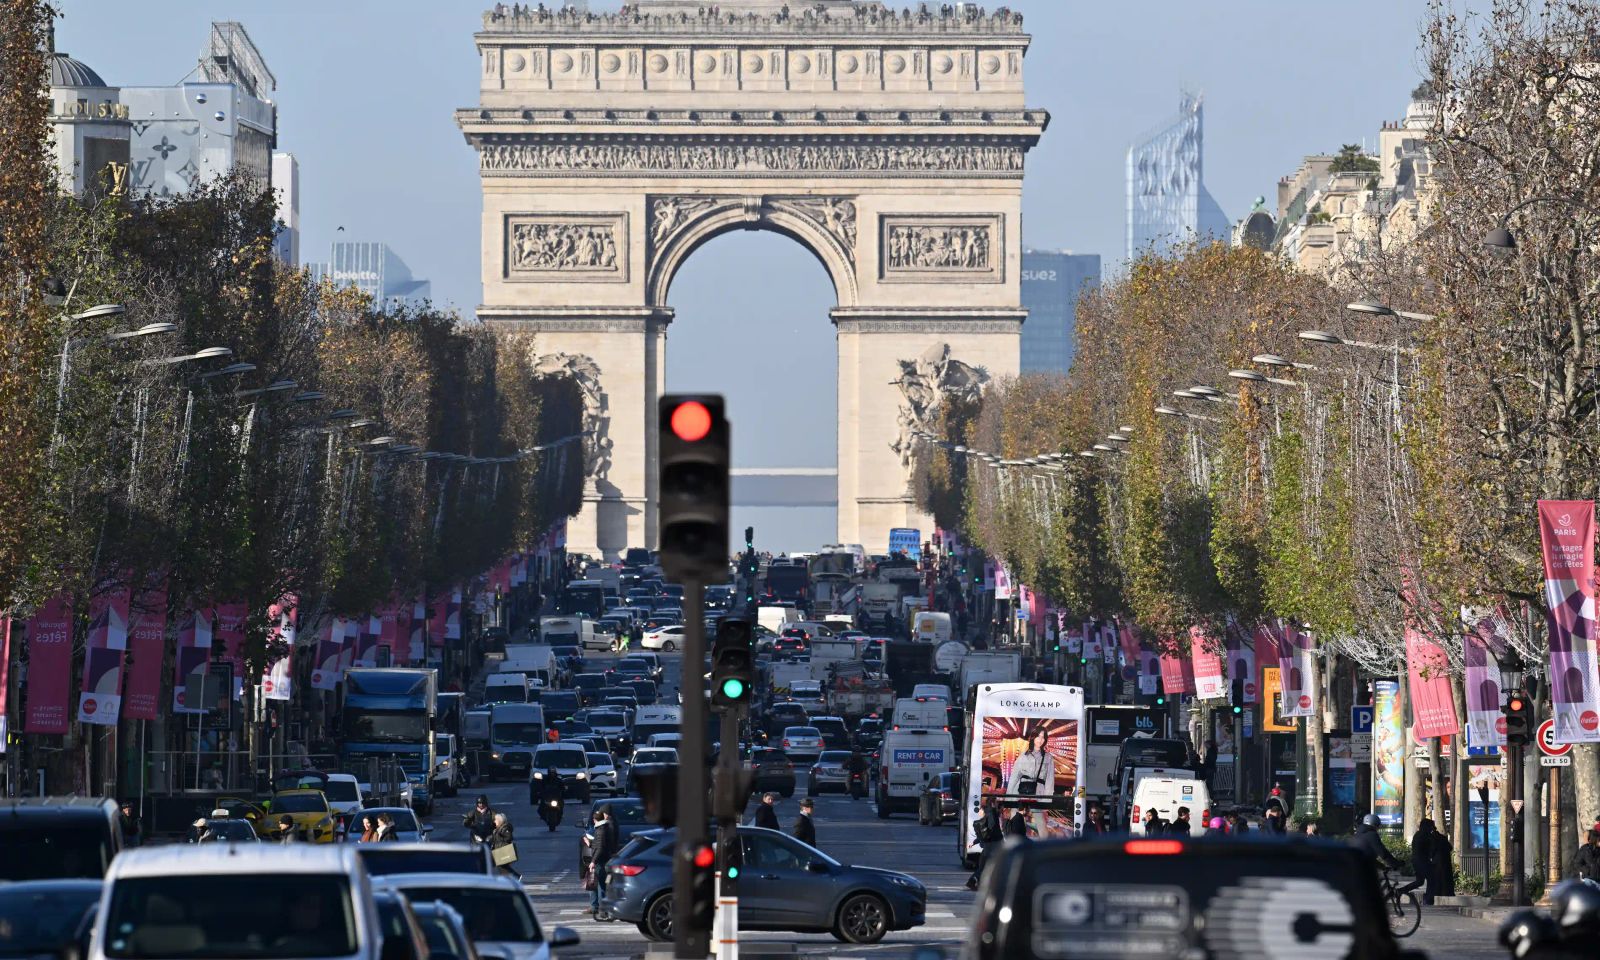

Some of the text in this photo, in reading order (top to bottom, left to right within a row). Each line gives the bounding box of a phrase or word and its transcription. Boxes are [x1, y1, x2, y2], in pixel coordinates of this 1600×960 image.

[1559, 552, 1584, 561] magie
[1000, 700, 1061, 708] LONGCHAMP
[1359, 711, 1371, 728] P
[897, 752, 917, 760] RENT
[924, 752, 941, 760] CAR
